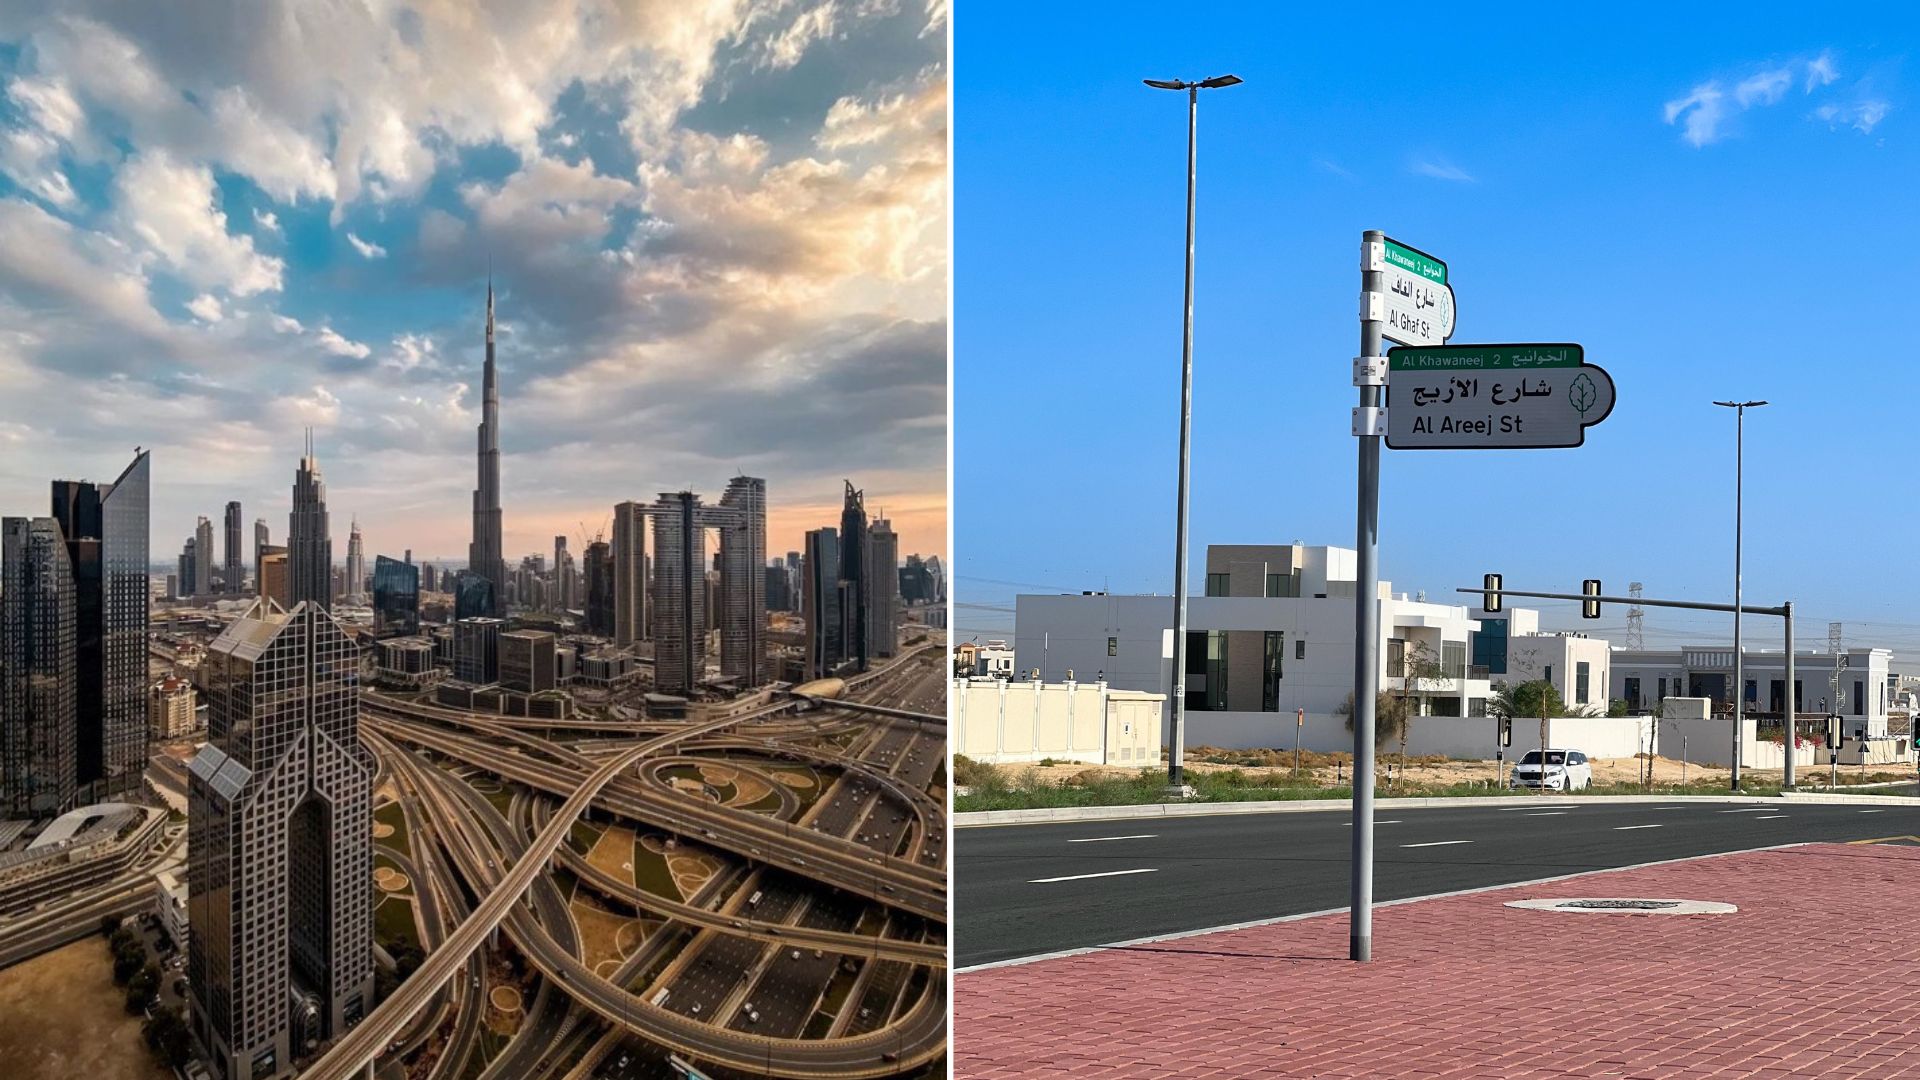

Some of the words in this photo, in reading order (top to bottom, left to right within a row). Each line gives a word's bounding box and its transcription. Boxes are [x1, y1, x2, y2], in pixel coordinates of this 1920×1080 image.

[1385, 248, 1391, 259] Al
[1391, 252, 1415, 271] Khawaneej
[1416, 260, 1421, 271] 2
[1423, 262, 1442, 278] الخوانيج
[1391, 274, 1412, 298] الغاف
[1415, 287, 1435, 309] شارع
[1389, 309, 1398, 328] Al
[1400, 312, 1419, 334] Ghaf
[1421, 320, 1430, 339] St
[1402, 355, 1415, 367] Al
[1419, 355, 1484, 367] Khawaneej
[1493, 353, 1501, 365] 2
[1512, 349, 1567, 367] الخوانيج
[1491, 377, 1552, 406] شارع
[1412, 415, 1434, 434] Al
[1440, 414, 1492, 436] Areej
[1500, 414, 1523, 433] St
